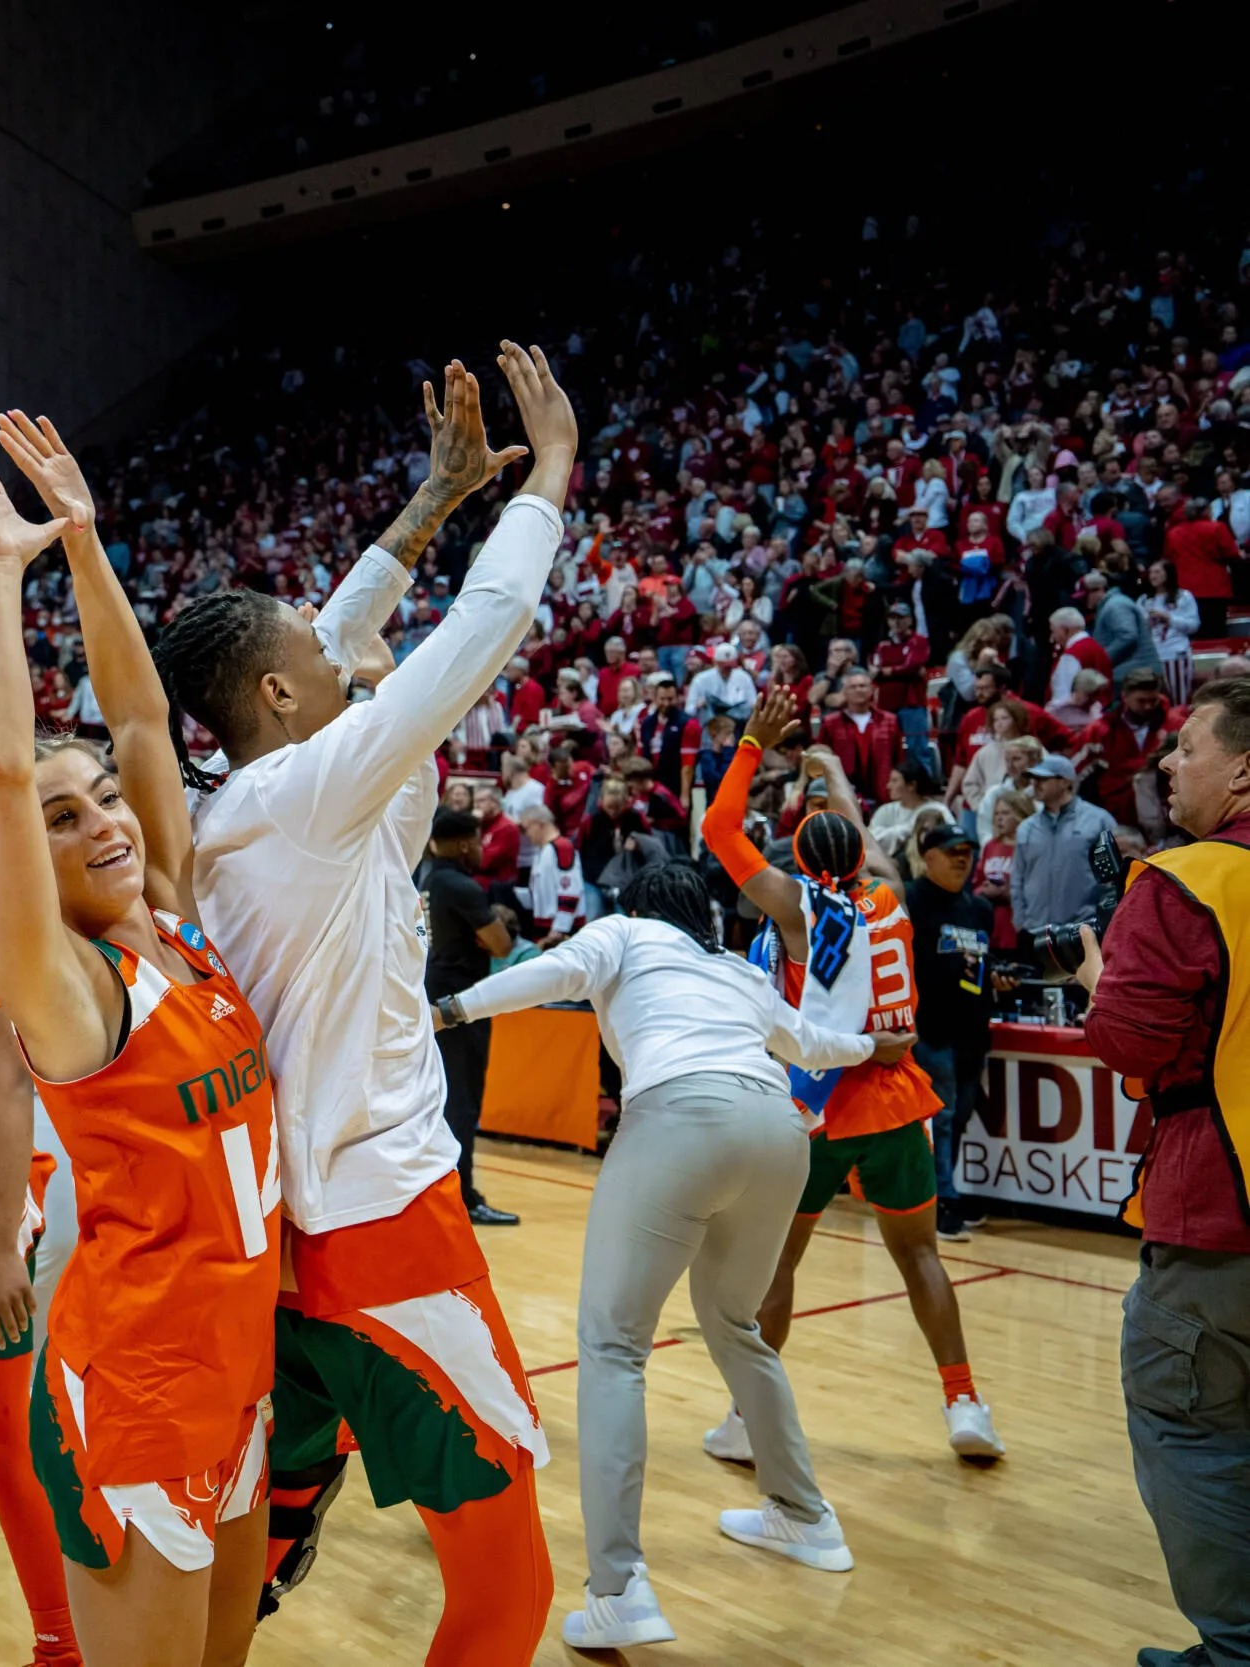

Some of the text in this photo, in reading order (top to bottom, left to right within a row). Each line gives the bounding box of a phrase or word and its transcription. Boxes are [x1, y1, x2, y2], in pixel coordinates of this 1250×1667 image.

[869, 938, 911, 1007] 3
[971, 1057, 1152, 1155] NDI
[962, 1140, 1138, 1204] BASKE
